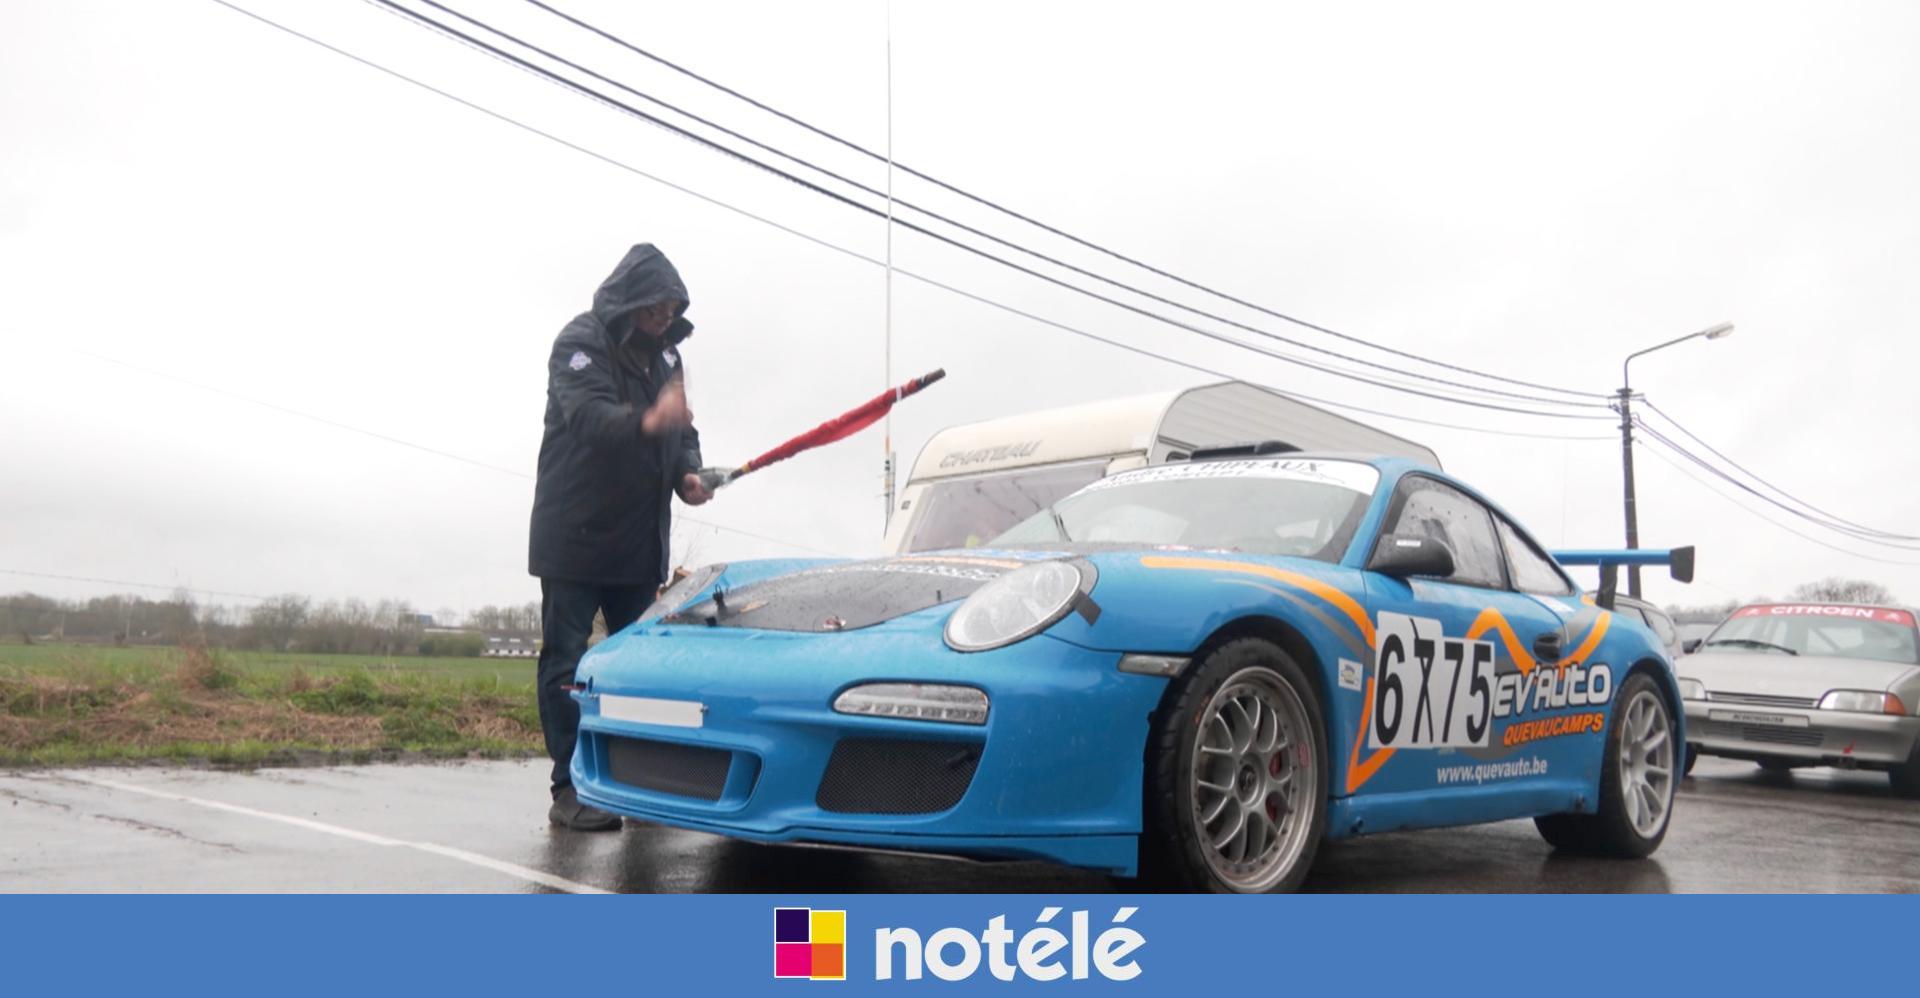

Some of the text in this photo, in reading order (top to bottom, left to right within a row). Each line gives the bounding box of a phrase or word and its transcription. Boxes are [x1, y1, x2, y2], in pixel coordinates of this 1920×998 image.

[939, 440, 1042, 468] CHATEAU
[1770, 605, 1875, 618] CITROEN
[1503, 712, 1604, 746] QUEVAUCAMPS
[1436, 756, 1548, 784] www.quevauto.be
